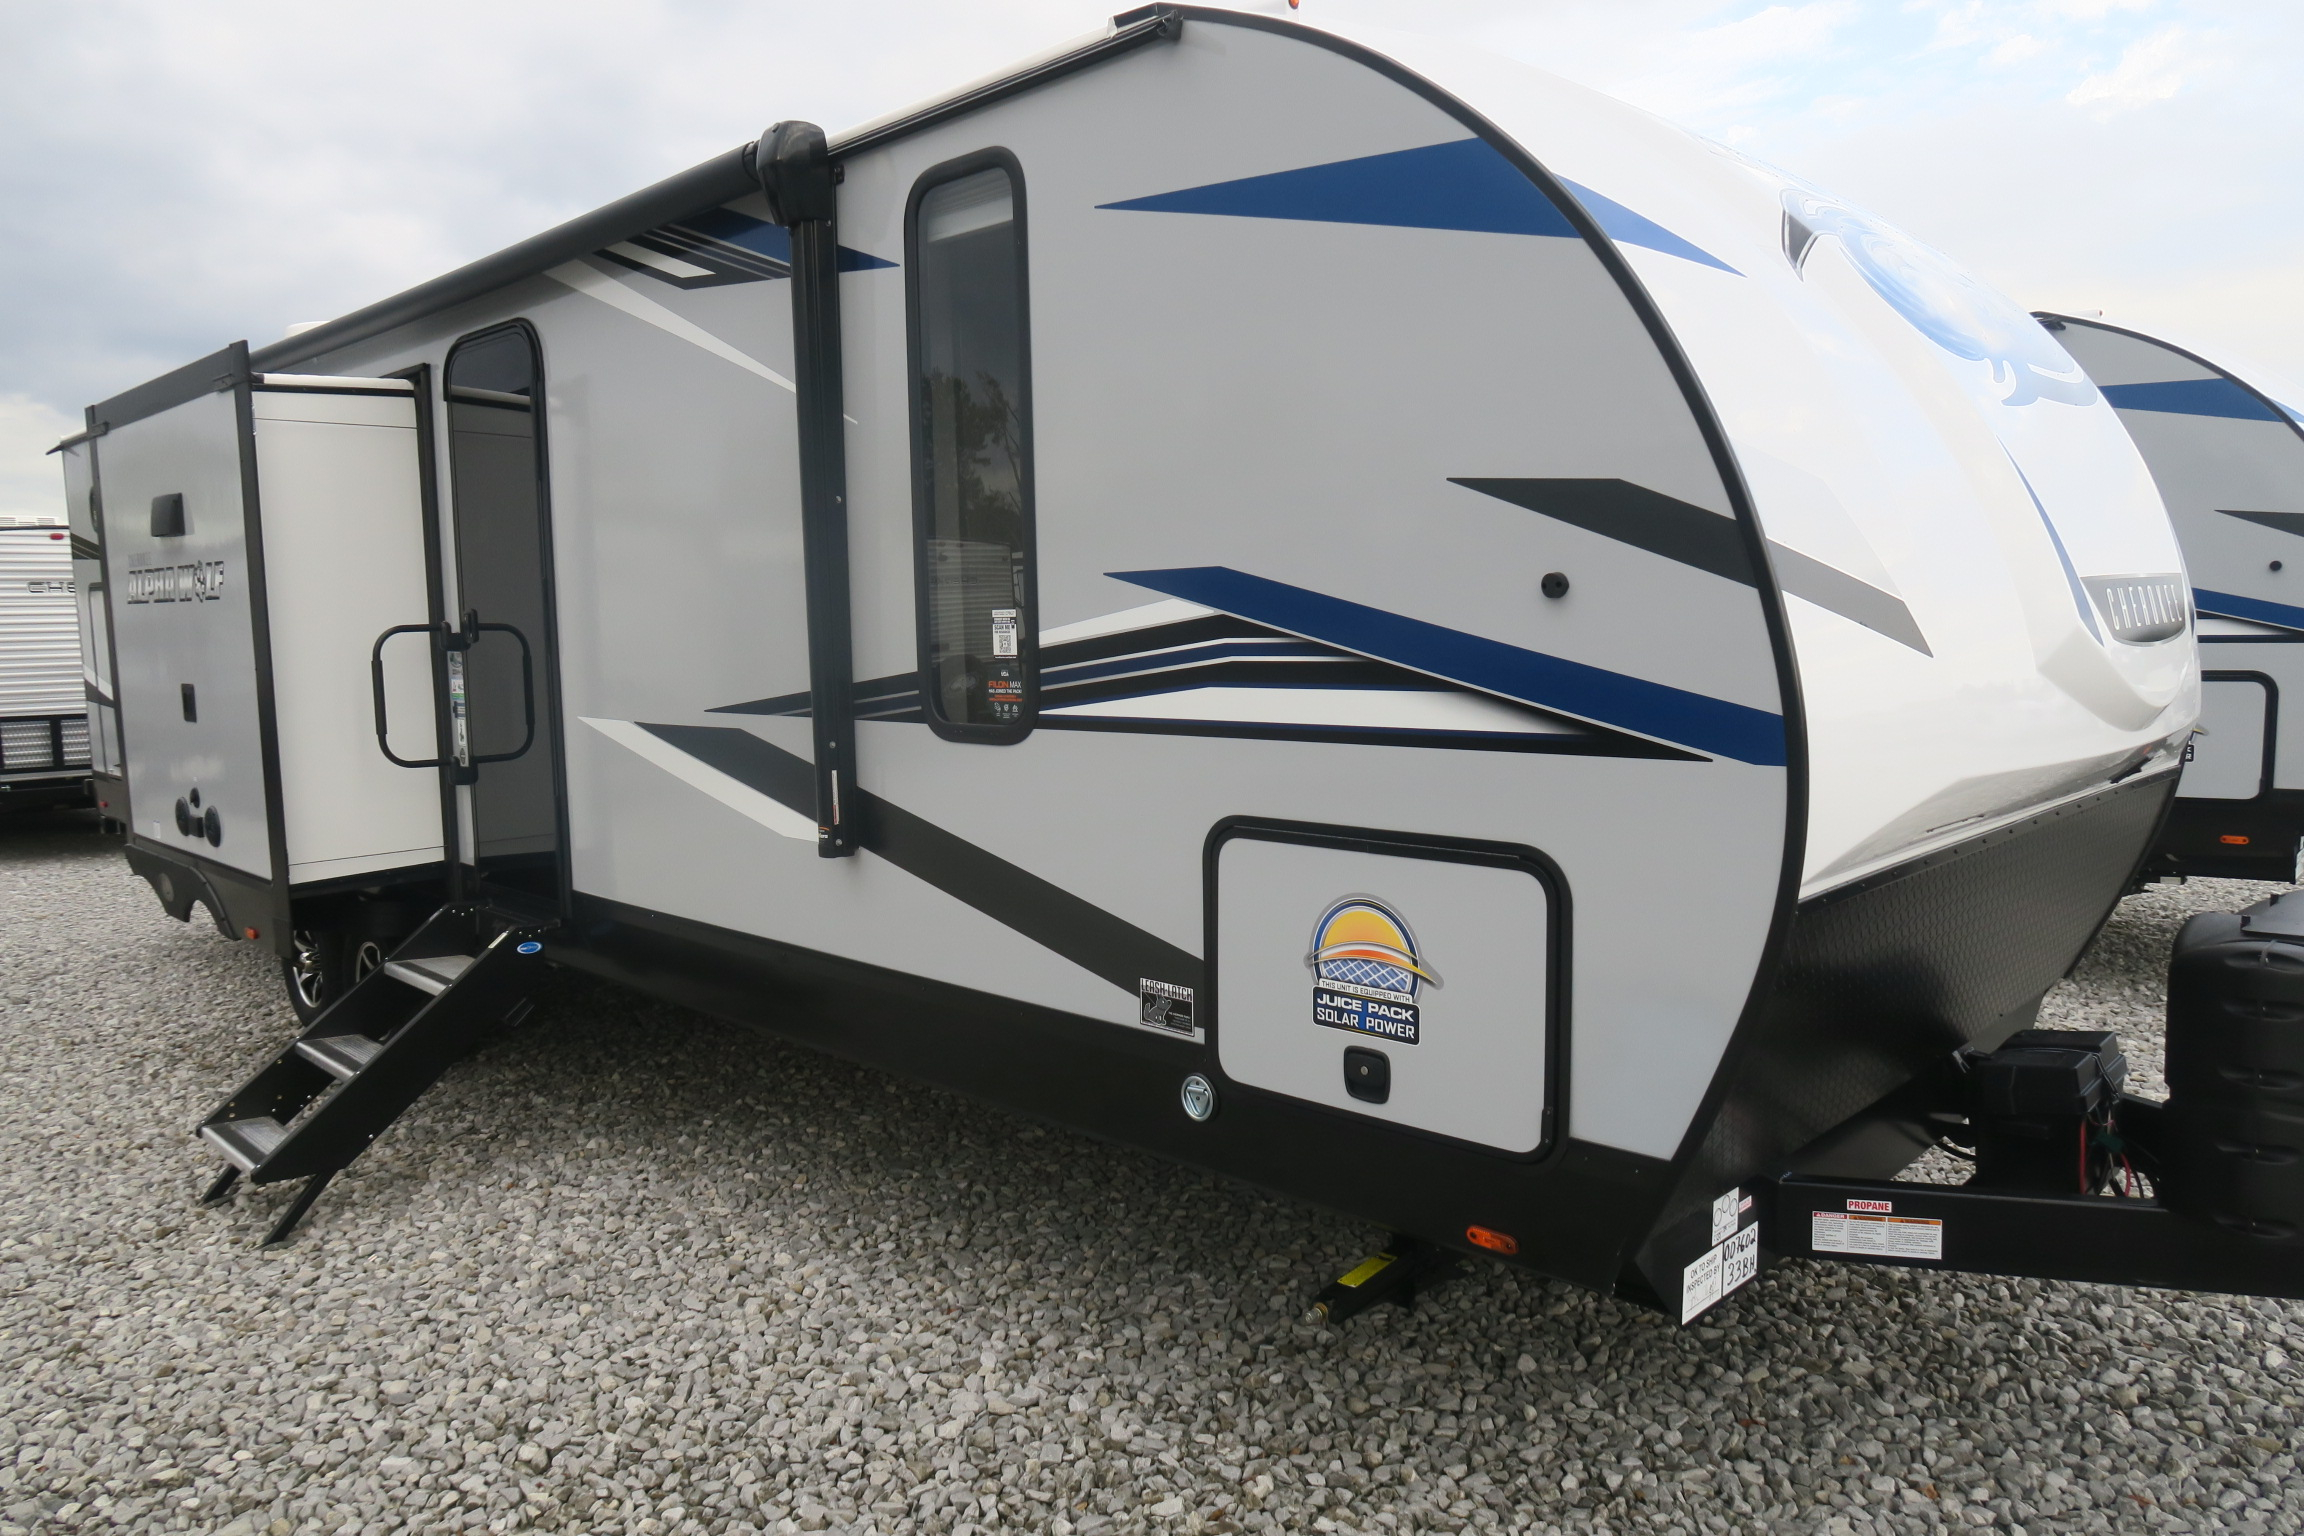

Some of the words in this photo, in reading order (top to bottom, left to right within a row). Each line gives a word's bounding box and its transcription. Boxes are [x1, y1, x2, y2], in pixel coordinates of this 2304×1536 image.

[127, 567, 175, 604] ALPHA
[2106, 584, 2182, 631] CHEROKEE
[1009, 680, 1022, 689] MAX
[1321, 980, 1336, 990] THIS
[1336, 983, 1351, 992] UNIT
[1352, 985, 1359, 994] IS
[1360, 987, 1392, 1000] EQUIPPED
[1392, 993, 1410, 1003] WITH
[1317, 993, 1362, 1011] JUICE
[1367, 1002, 1414, 1022] PACK
[1316, 1008, 1359, 1028] SOLAR
[1365, 1017, 1415, 1039] POWER
[1848, 1200, 1890, 1211] PROPANE
[1686, 1270, 1713, 1294] INSPECTED
[1713, 1262, 1721, 1276] BY
[1690, 1266, 1698, 1279] OK
[1698, 1260, 1706, 1273] TO
[1706, 1253, 1718, 1269] SHIP
